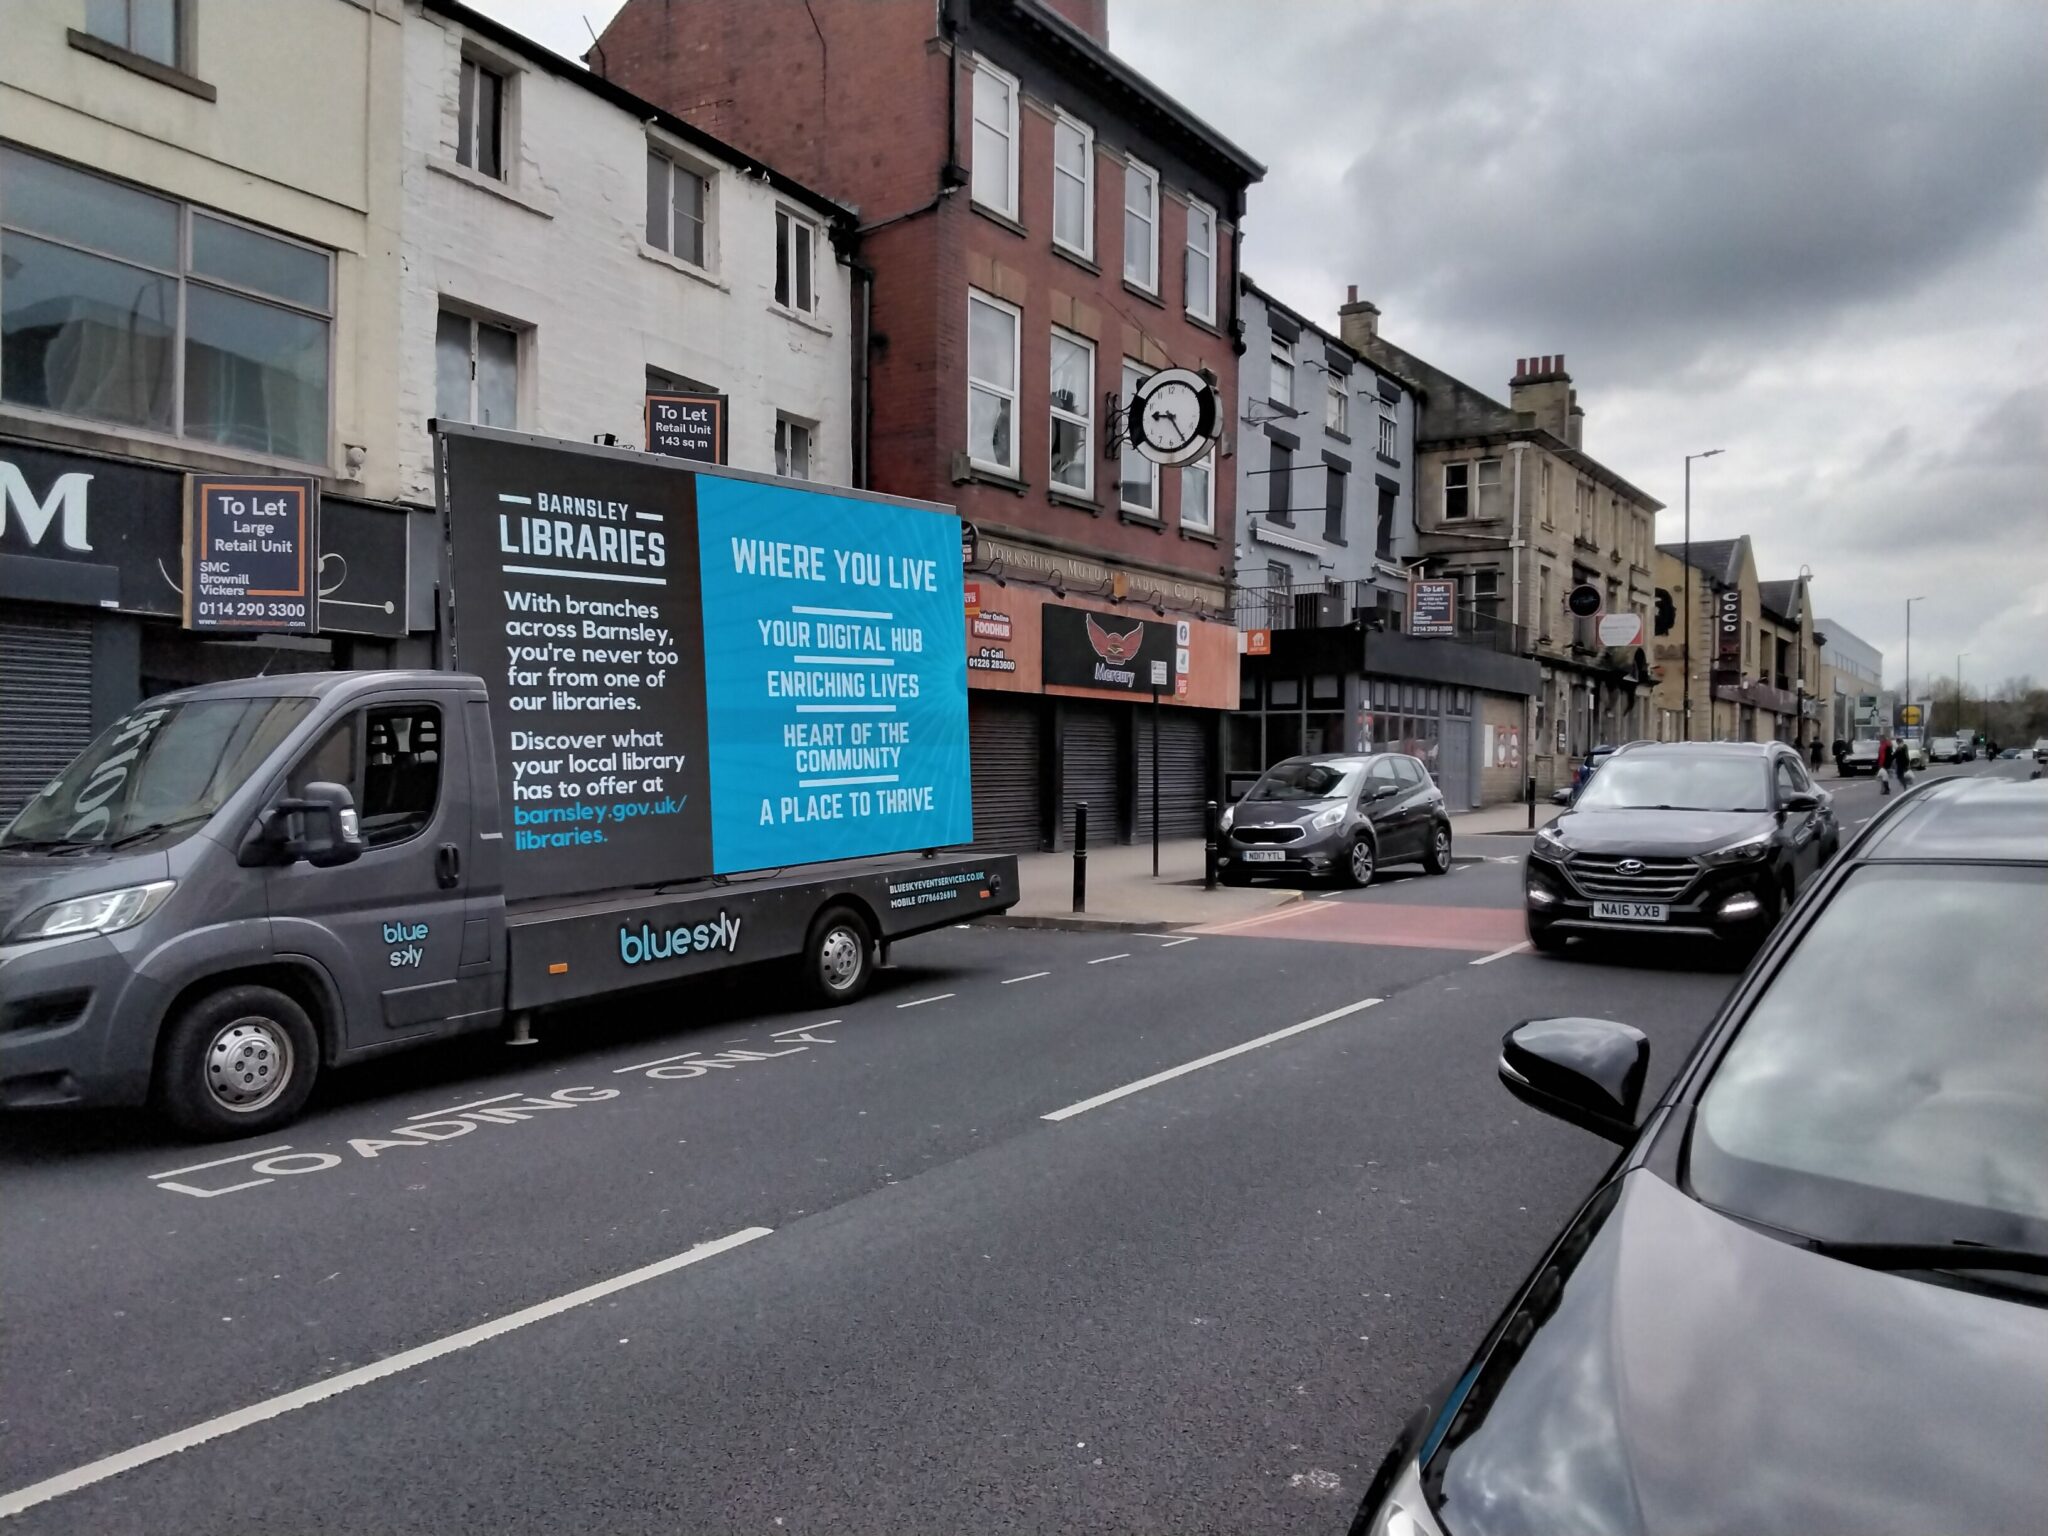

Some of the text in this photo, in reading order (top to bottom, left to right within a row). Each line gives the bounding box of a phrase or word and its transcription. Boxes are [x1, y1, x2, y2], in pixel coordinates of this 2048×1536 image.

[658, 405, 708, 421] To Let
[656, 422, 711, 435] Retail Unit
[660, 436, 680, 446] 143
[682, 439, 695, 449] sq
[218, 496, 287, 516] To Let
[538, 492, 629, 521] BARNSLEY
[233, 521, 274, 537] Large
[215, 539, 292, 553] Retail Unit
[500, 514, 666, 567] LIBRARIES
[200, 562, 230, 573] SMC
[731, 537, 937, 592] WHERE YOU LIVE
[200, 573, 249, 585] Brownill
[200, 585, 244, 596] Vickers
[199, 602, 305, 617] 0114 290 3300
[504, 590, 659, 619] With branches
[506, 620, 674, 646] across Barnsley,
[758, 619, 923, 652] YOUR DIGITAL HUB
[974, 621, 1010, 637] FOODHUB
[507, 642, 679, 665] you're never too
[969, 658, 990, 668] 01226
[981, 648, 1004, 659] Or Call
[507, 666, 666, 688] far from one of
[767, 670, 919, 698] ENRICHING LIVES
[1094, 662, 1135, 688] Mercury
[509, 691, 641, 711] our libraries.
[511, 729, 663, 751] Discover what
[784, 722, 909, 747] HEART OF THE
[512, 752, 685, 780] your local library
[796, 747, 901, 773] COMMUNITY
[513, 776, 663, 800] has to offer at
[514, 795, 687, 825] barnsley.gov.uk/
[760, 786, 934, 826] A PLACE TO THRIVE
[515, 826, 608, 850] libraries.
[891, 896, 916, 909] MOBILE
[1601, 903, 1660, 917] NA16 XXB
[383, 922, 428, 943] blue
[620, 911, 741, 964] bluesky
[390, 944, 423, 967] sky
[157, 1031, 838, 1198] LOADING ONLY
